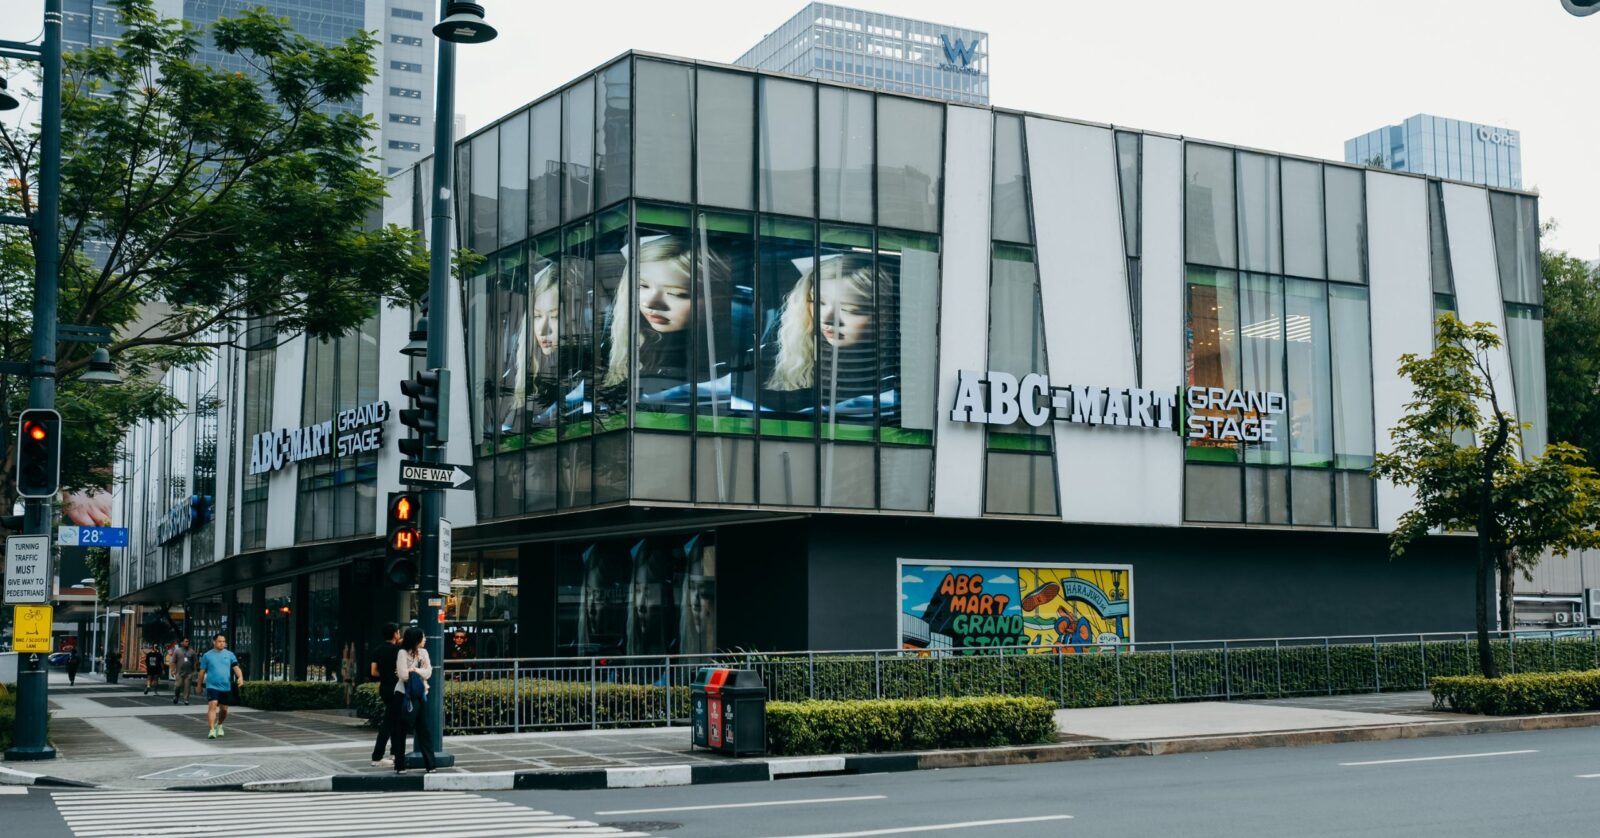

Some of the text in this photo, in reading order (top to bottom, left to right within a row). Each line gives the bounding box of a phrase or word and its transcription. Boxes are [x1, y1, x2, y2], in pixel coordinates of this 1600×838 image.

[941, 33, 979, 66] W
[951, 369, 1176, 427] ABC-MART
[1187, 385, 1286, 414] GRAND
[337, 400, 386, 432] GRAND
[1187, 415, 1278, 442] STAGE
[250, 420, 332, 475] ABC-MART
[337, 428, 380, 457] STAGE
[405, 467, 453, 481] ONE WAY
[397, 532, 412, 549] 14
[16, 565, 35, 574] MUST
[7, 589, 44, 597] PEDESTRIANS
[940, 573, 984, 596] ABC
[949, 594, 1009, 615] MART
[952, 614, 1023, 635] GRAND
